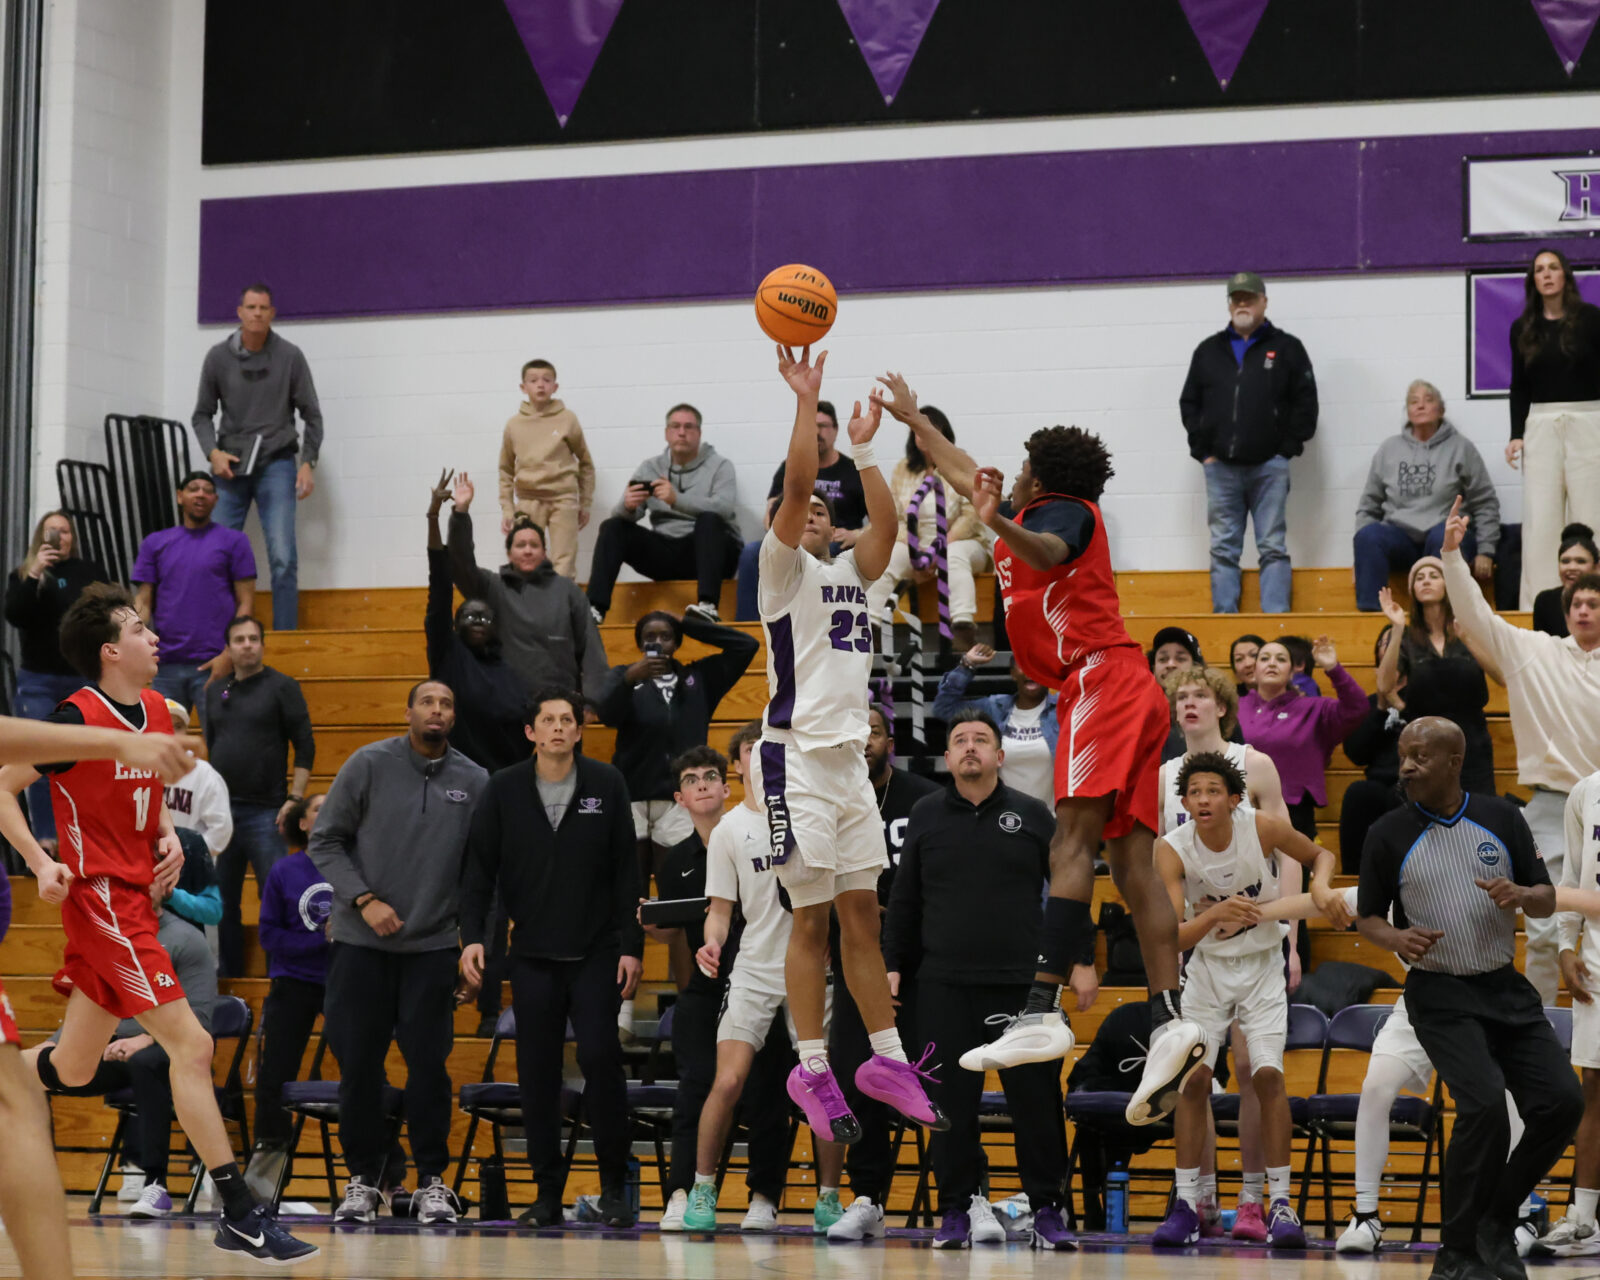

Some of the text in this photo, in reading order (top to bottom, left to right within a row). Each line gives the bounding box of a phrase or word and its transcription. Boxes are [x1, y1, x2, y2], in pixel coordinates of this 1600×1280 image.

[777, 291, 829, 321] Wilson
[828, 609, 872, 654] 23
[132, 786, 151, 832] 11
[767, 794, 787, 857] SOUTH
